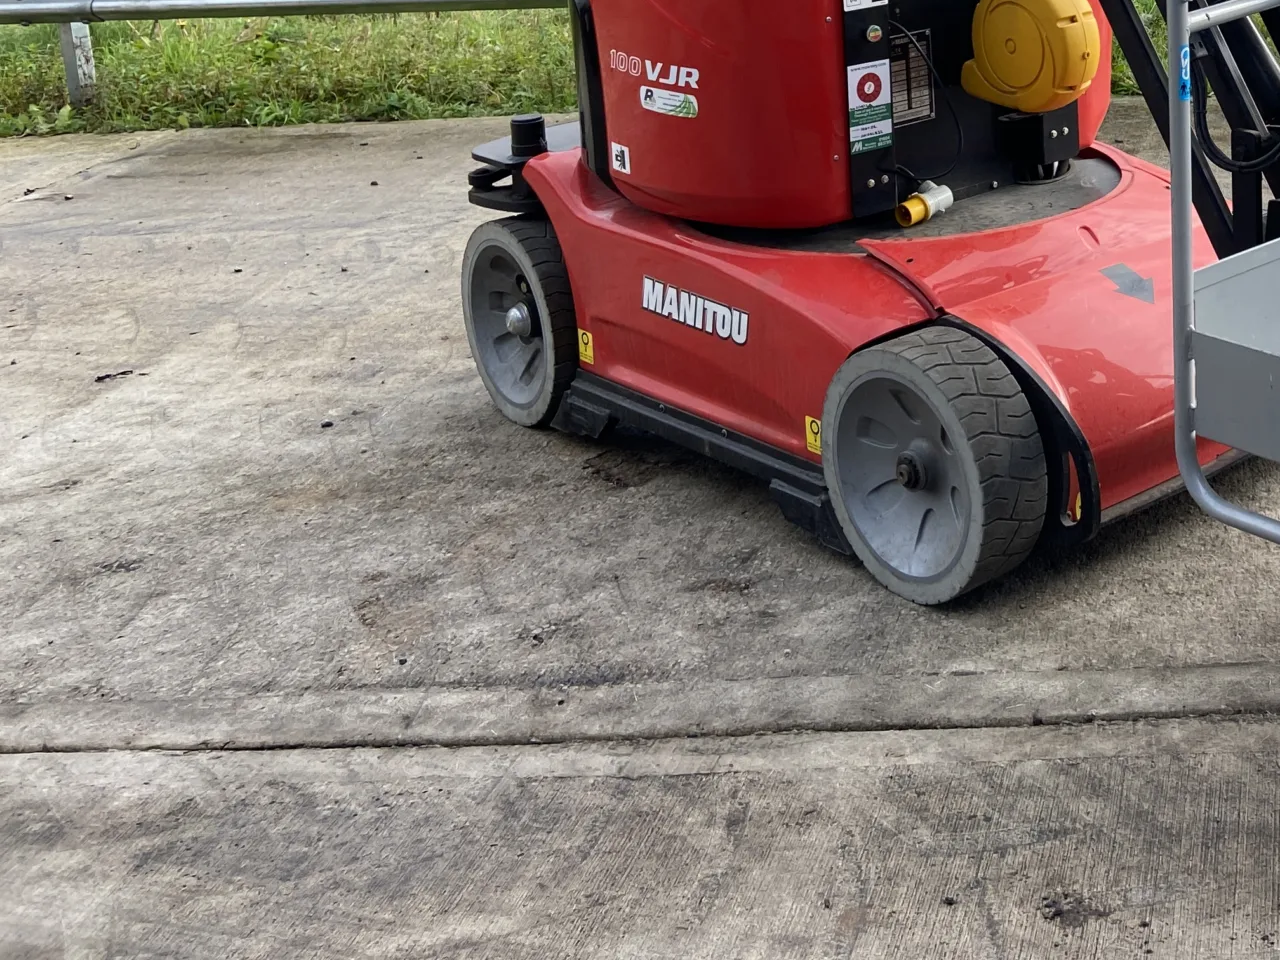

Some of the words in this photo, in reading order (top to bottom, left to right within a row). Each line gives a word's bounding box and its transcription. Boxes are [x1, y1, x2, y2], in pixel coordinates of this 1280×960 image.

[610, 48, 642, 77] 100
[645, 59, 699, 89] VJR
[642, 275, 750, 346] MANITOU
